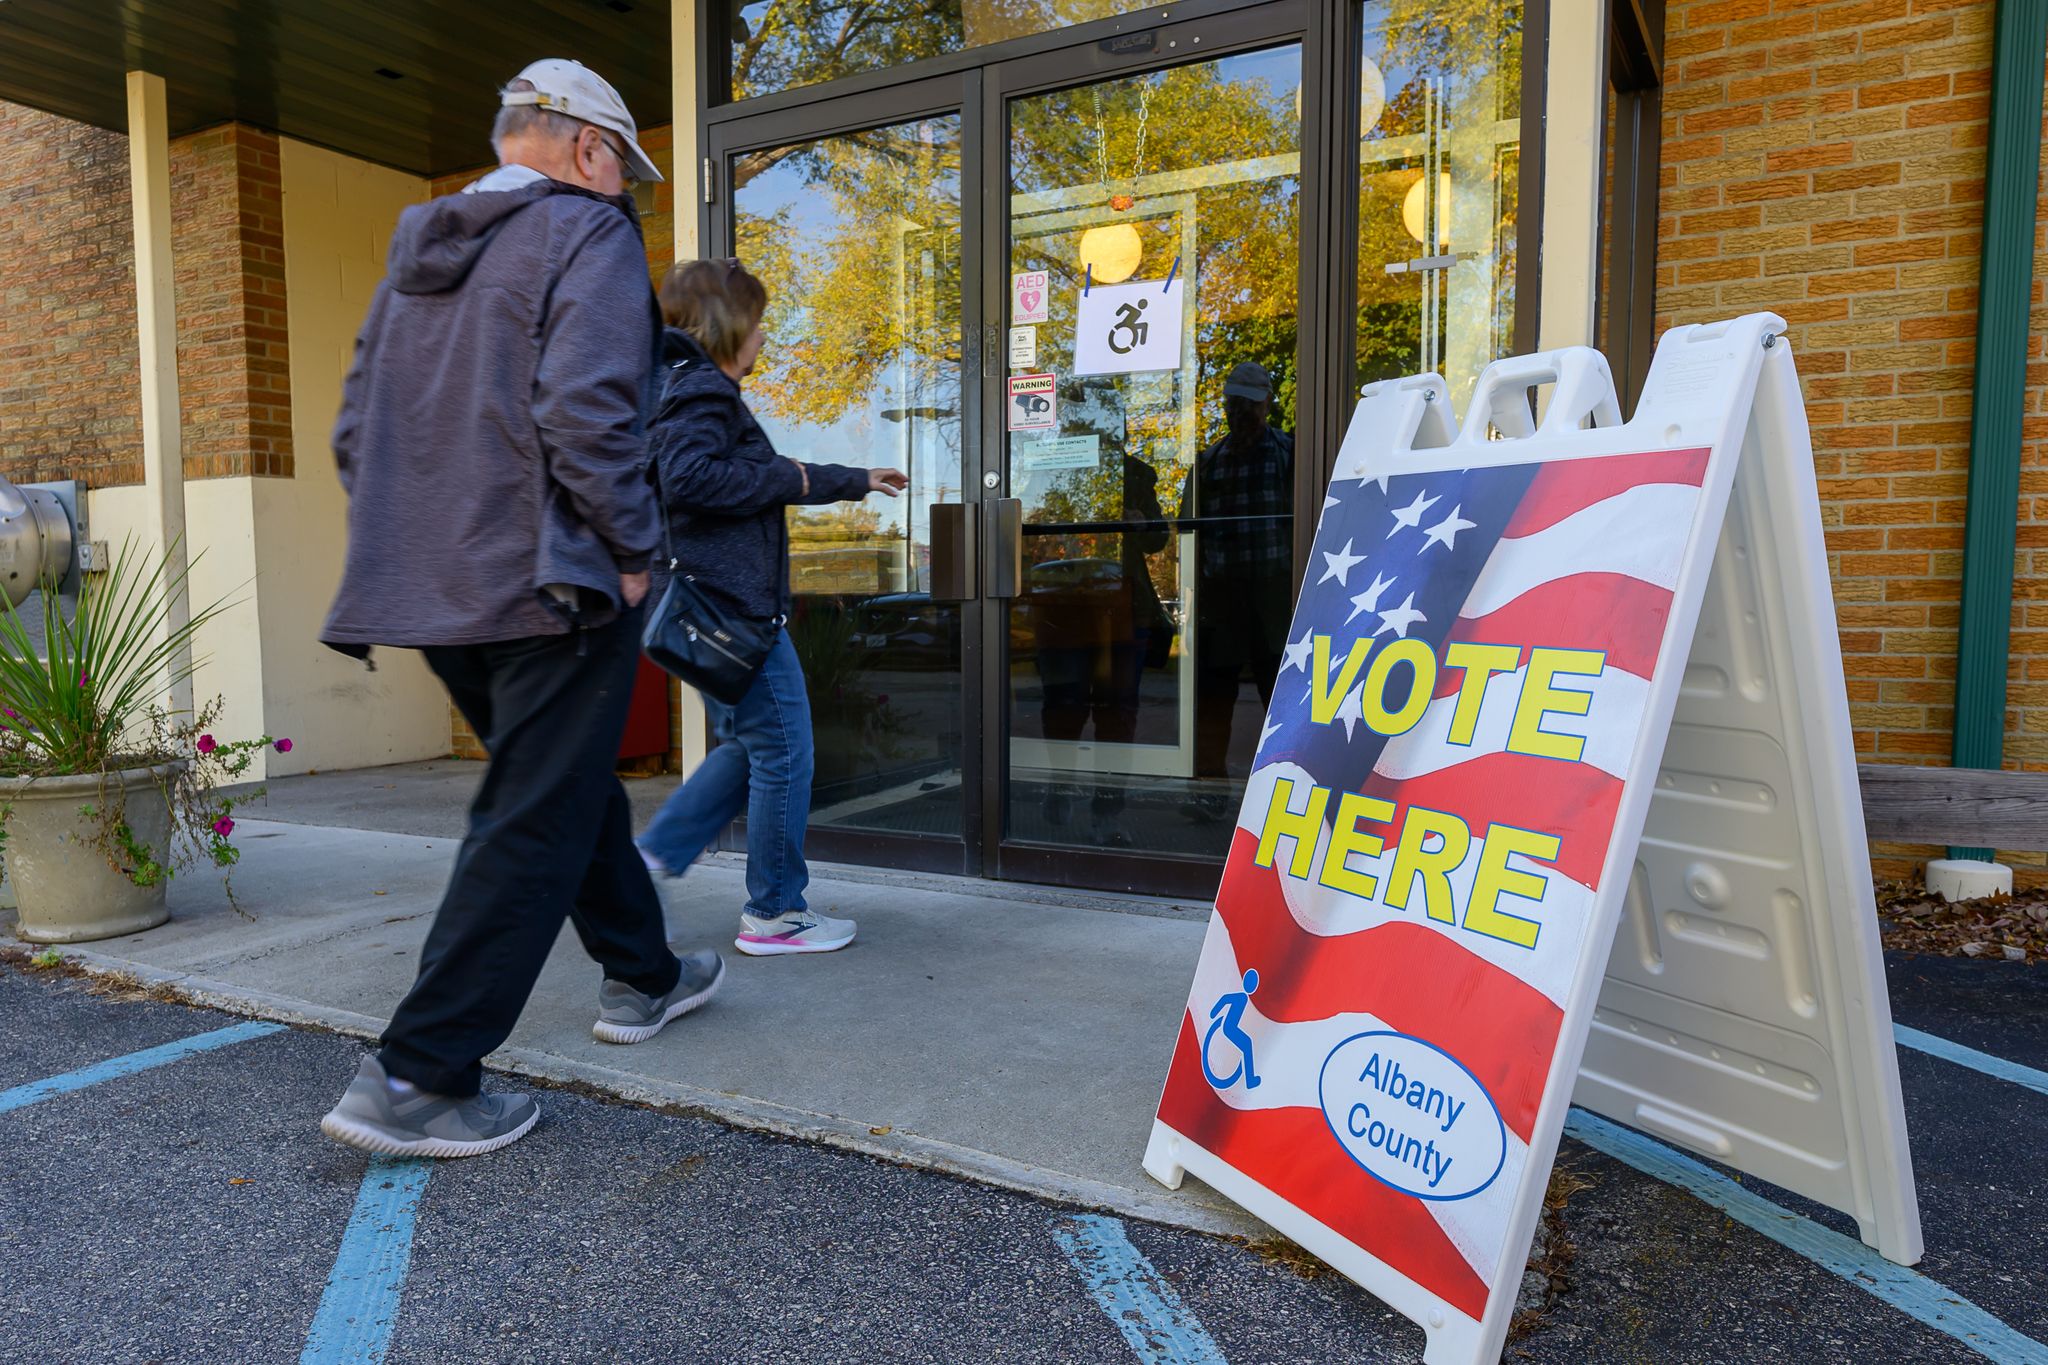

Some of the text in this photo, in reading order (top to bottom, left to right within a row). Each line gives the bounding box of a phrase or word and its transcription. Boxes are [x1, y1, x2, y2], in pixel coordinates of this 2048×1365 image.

[1015, 312, 1047, 321] EQUIPPED
[1016, 274, 1045, 289] AED
[1012, 380, 1052, 390] WARNING
[1311, 634, 1608, 762] VOTE
[1253, 777, 1563, 951] HERE
[1359, 1053, 1465, 1132] Albany
[1348, 1102, 1452, 1188] County
